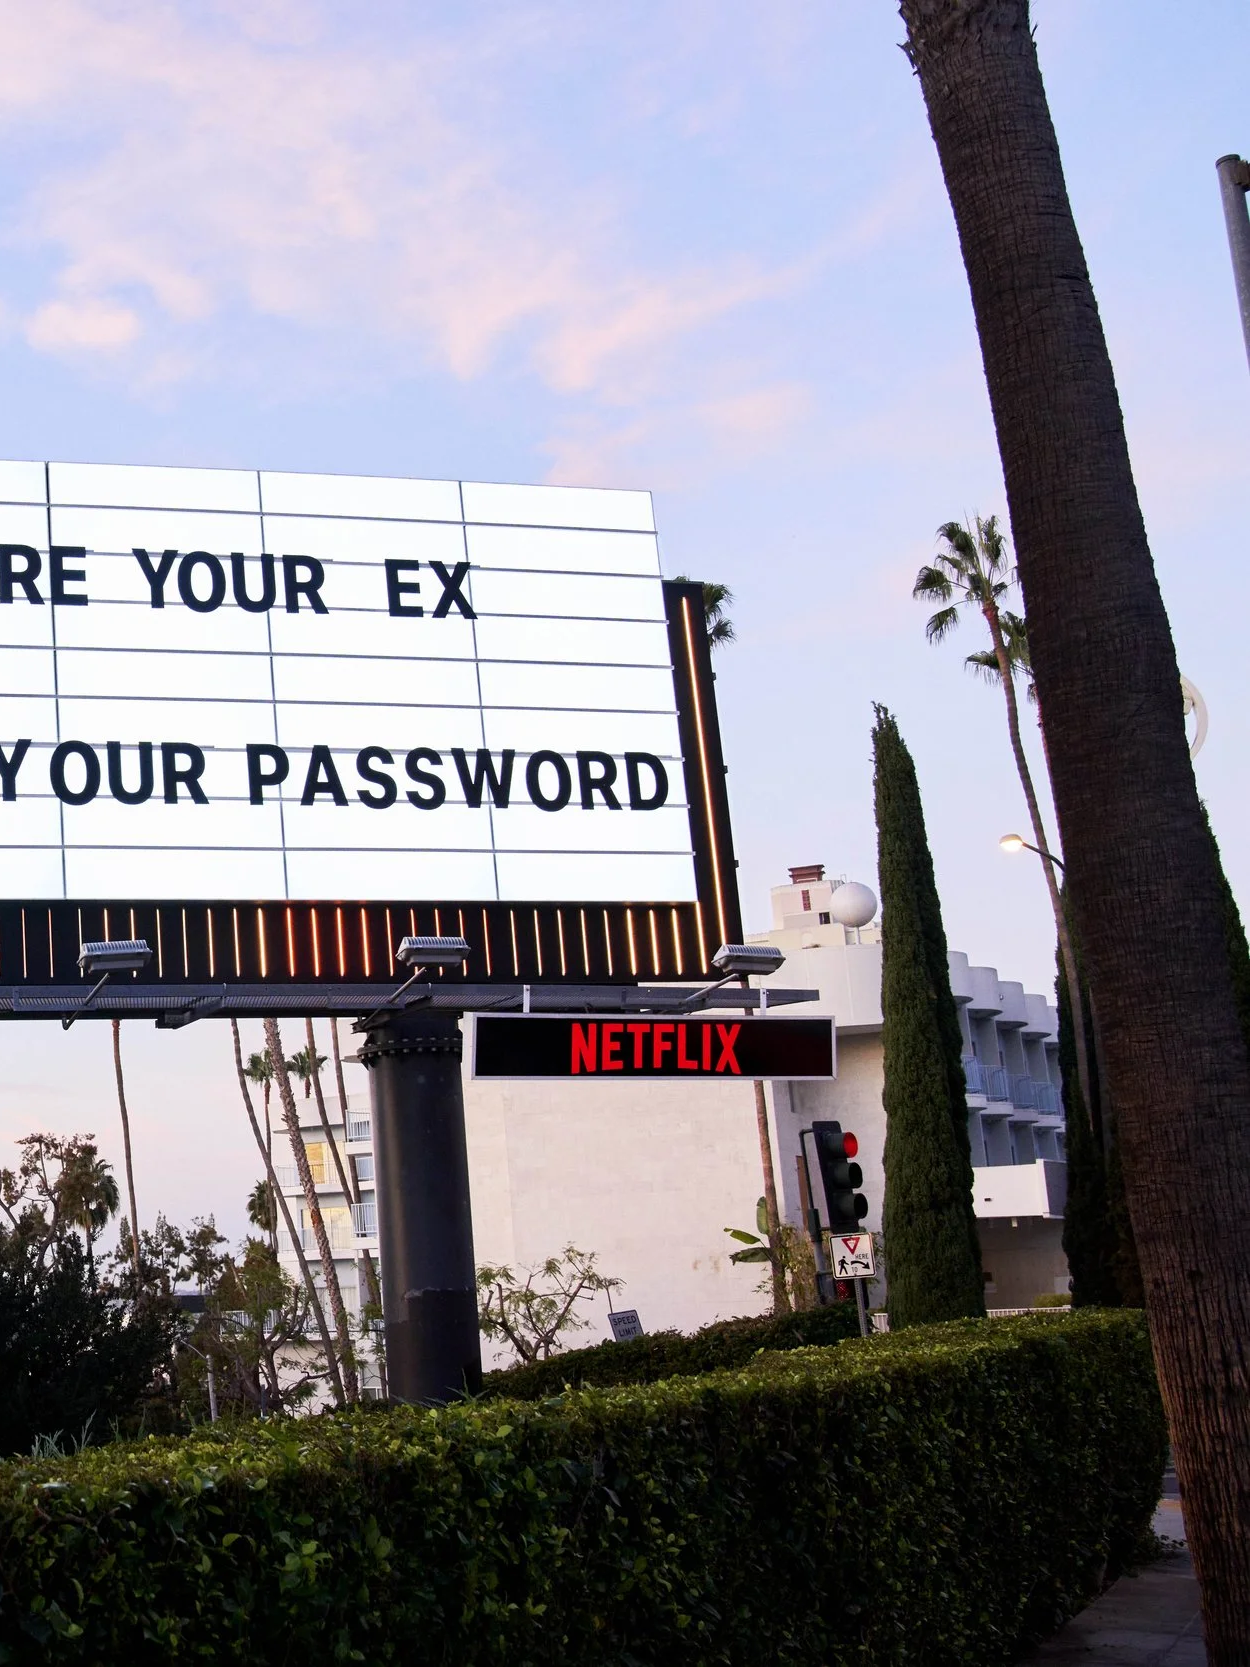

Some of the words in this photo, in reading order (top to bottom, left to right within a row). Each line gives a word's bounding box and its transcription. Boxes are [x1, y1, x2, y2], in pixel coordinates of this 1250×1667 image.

[132, 548, 327, 614] YOUR
[385, 559, 476, 620] EX
[246, 743, 669, 812] PASSWORD
[570, 1022, 742, 1075] NETFLIX
[612, 1315, 637, 1326] SPEED
[618, 1326, 637, 1337] LIMIT
